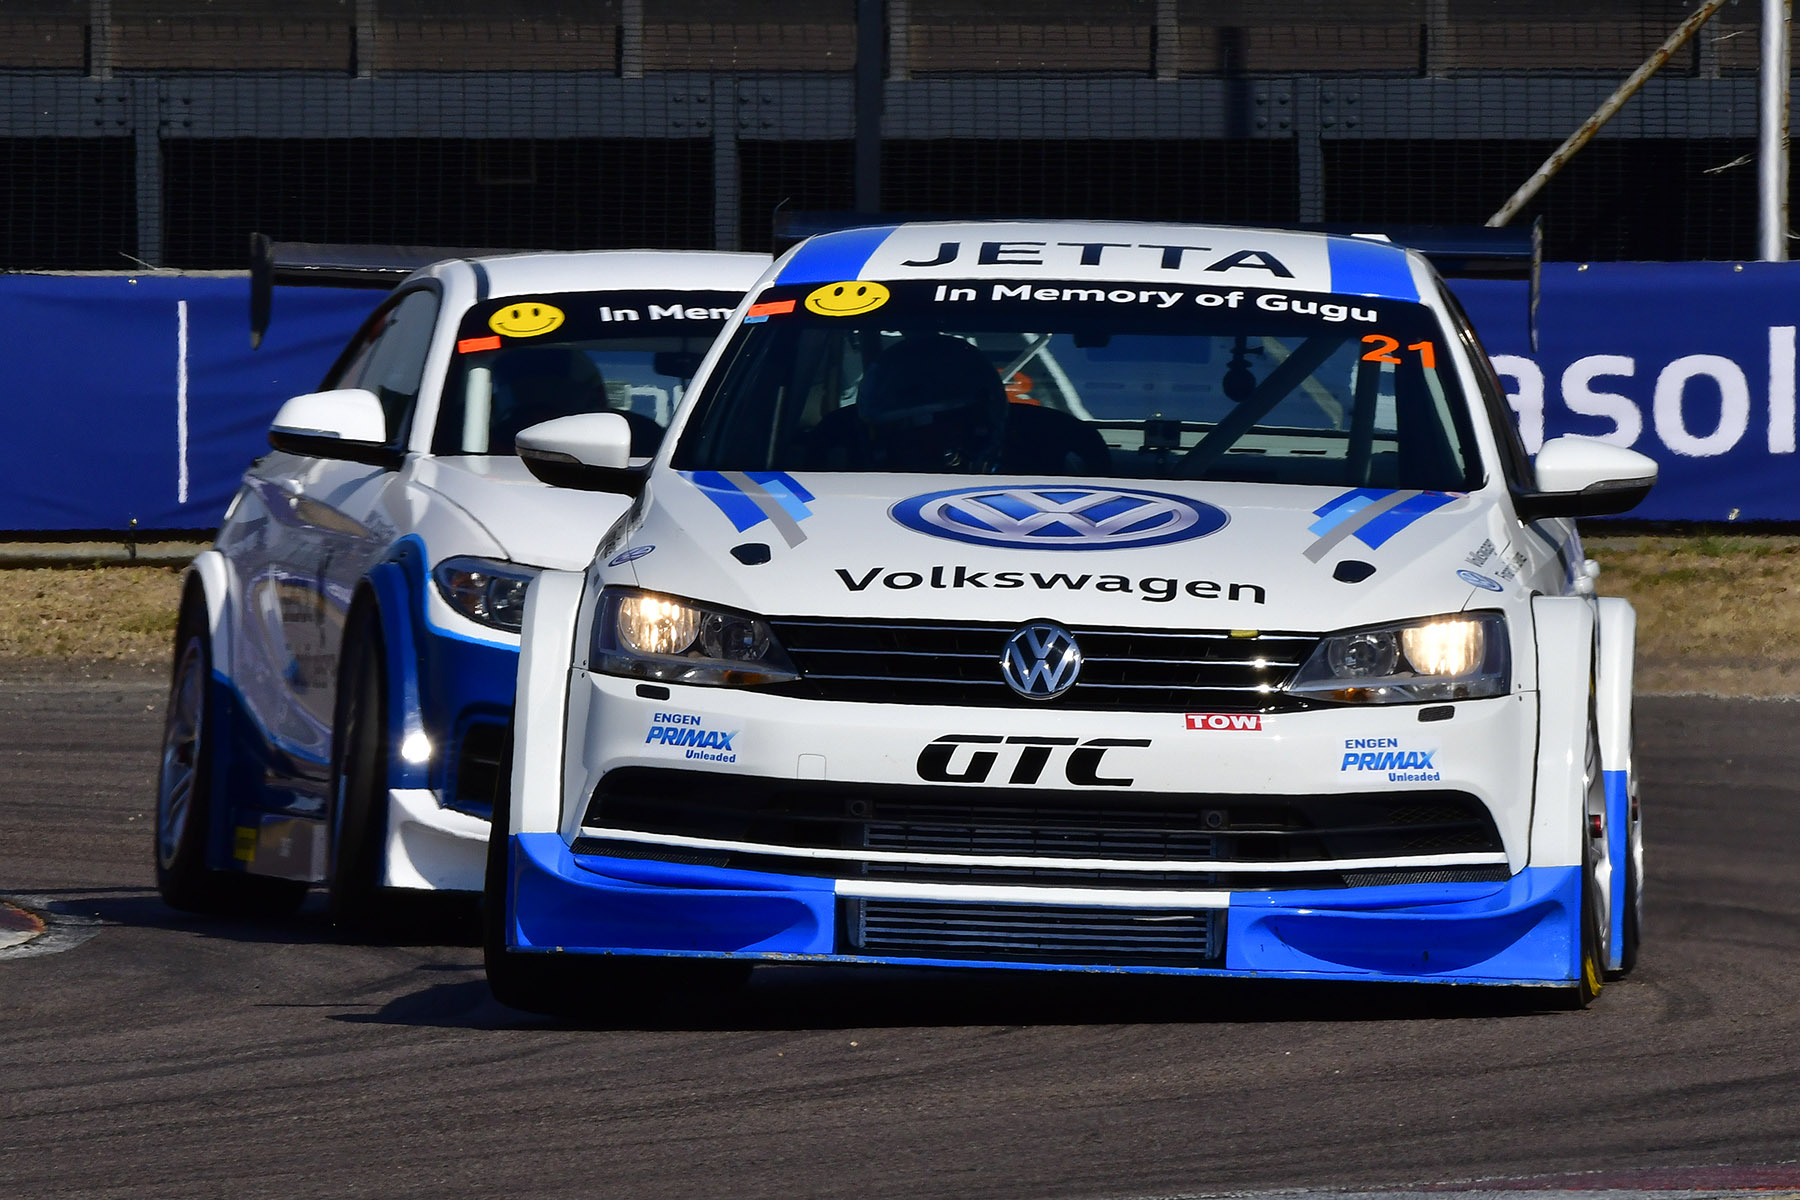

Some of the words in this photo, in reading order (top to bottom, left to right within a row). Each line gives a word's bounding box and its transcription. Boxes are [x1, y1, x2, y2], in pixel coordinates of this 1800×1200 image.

[901, 241, 1296, 279] JETTA
[599, 306, 640, 322] In
[934, 285, 977, 302] In
[991, 284, 1184, 309] Memory
[1195, 291, 1245, 308] of
[1256, 294, 1378, 323] Gugu
[1360, 334, 1436, 369] 21
[834, 565, 1267, 605] Volkswagen
[653, 712, 701, 726] ENGEN
[1187, 714, 1259, 730] TOW
[645, 726, 739, 751] PRIMAX
[1345, 738, 1398, 749] ENGEN
[685, 749, 736, 763] Unleaded
[916, 734, 1153, 788] GTC
[1341, 747, 1438, 771] PRIMAX
[1388, 771, 1440, 782] Unleaded
